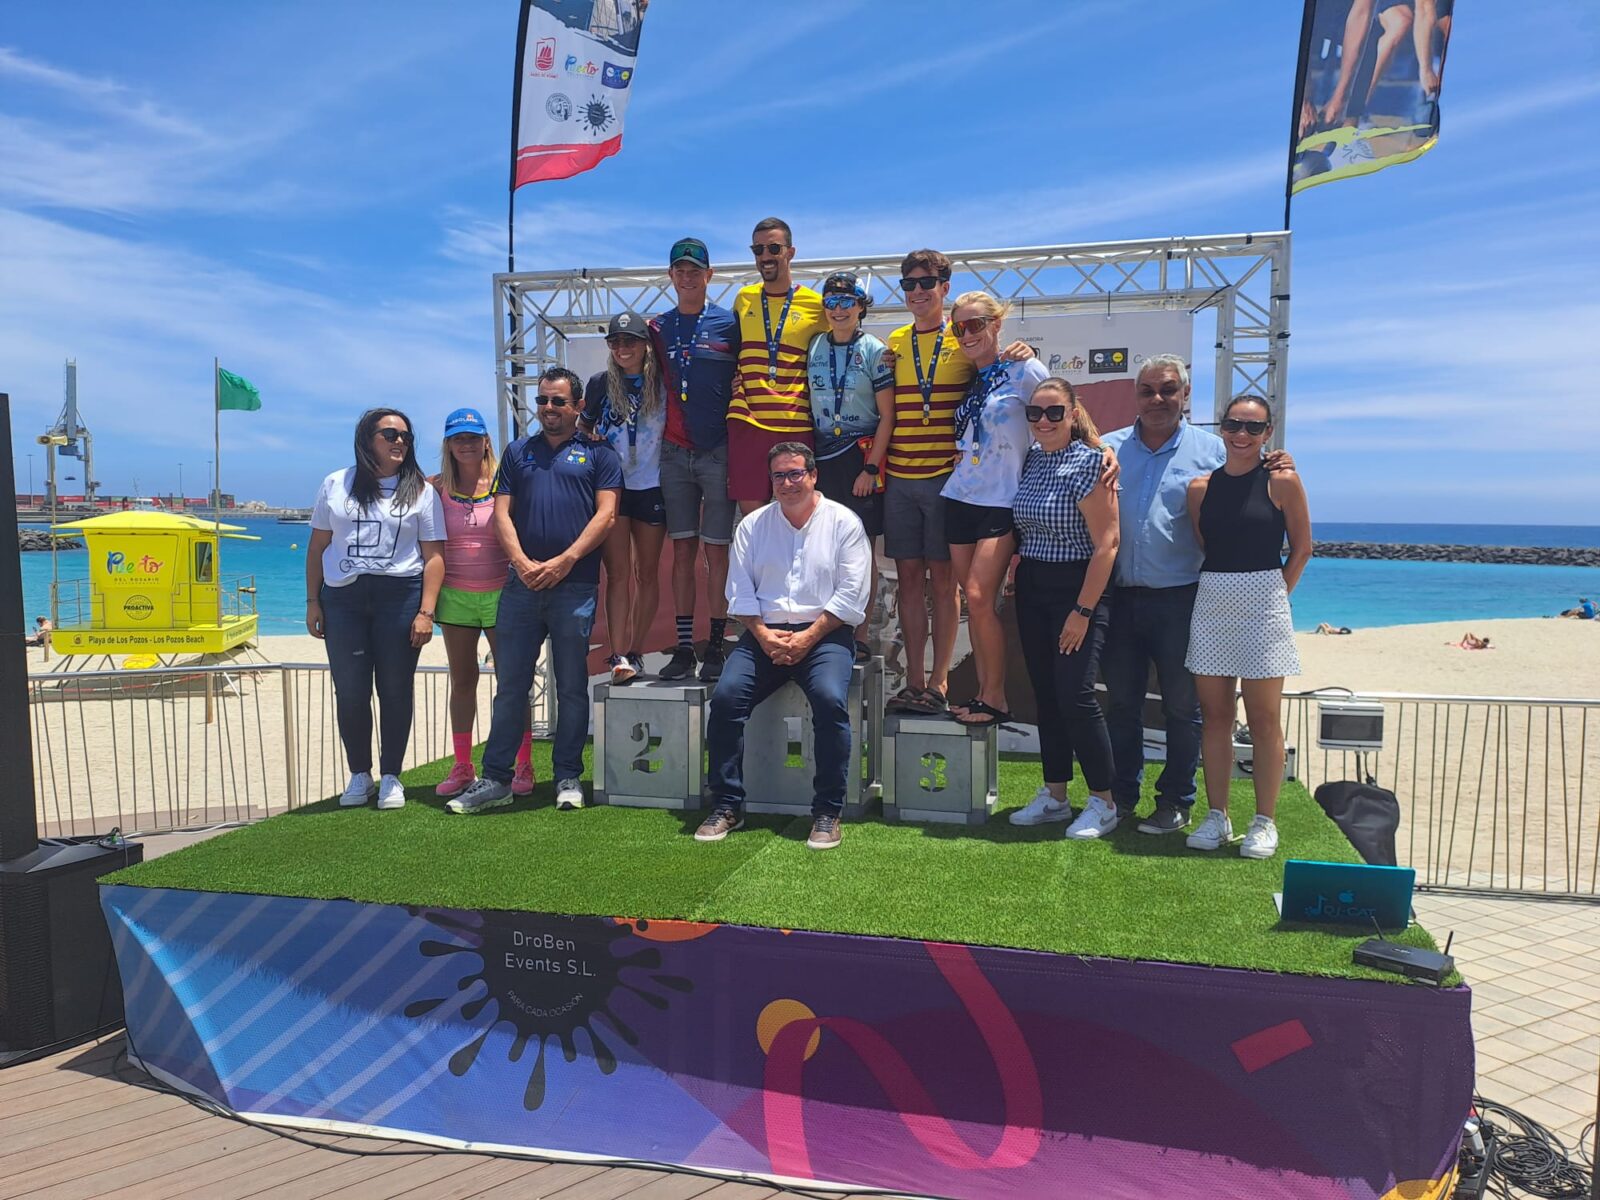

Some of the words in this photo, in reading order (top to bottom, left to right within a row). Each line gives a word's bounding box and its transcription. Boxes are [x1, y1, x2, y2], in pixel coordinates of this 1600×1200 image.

[1048, 353, 1086, 370] Puerto
[88, 635, 106, 645] Playa
[107, 635, 115, 643] de
[116, 636, 128, 644] Los
[129, 635, 148, 643] Pozos
[153, 635, 164, 643] Los
[165, 635, 185, 643] Pozos
[185, 635, 204, 643] Beach
[631, 722, 663, 774] 2
[919, 752, 948, 793] 3
[513, 931, 575, 951] DroBen
[505, 952, 560, 973] Events
[567, 959, 596, 976] S.L.
[507, 990, 525, 1010] PARA
[525, 1005, 548, 1017] CADA
